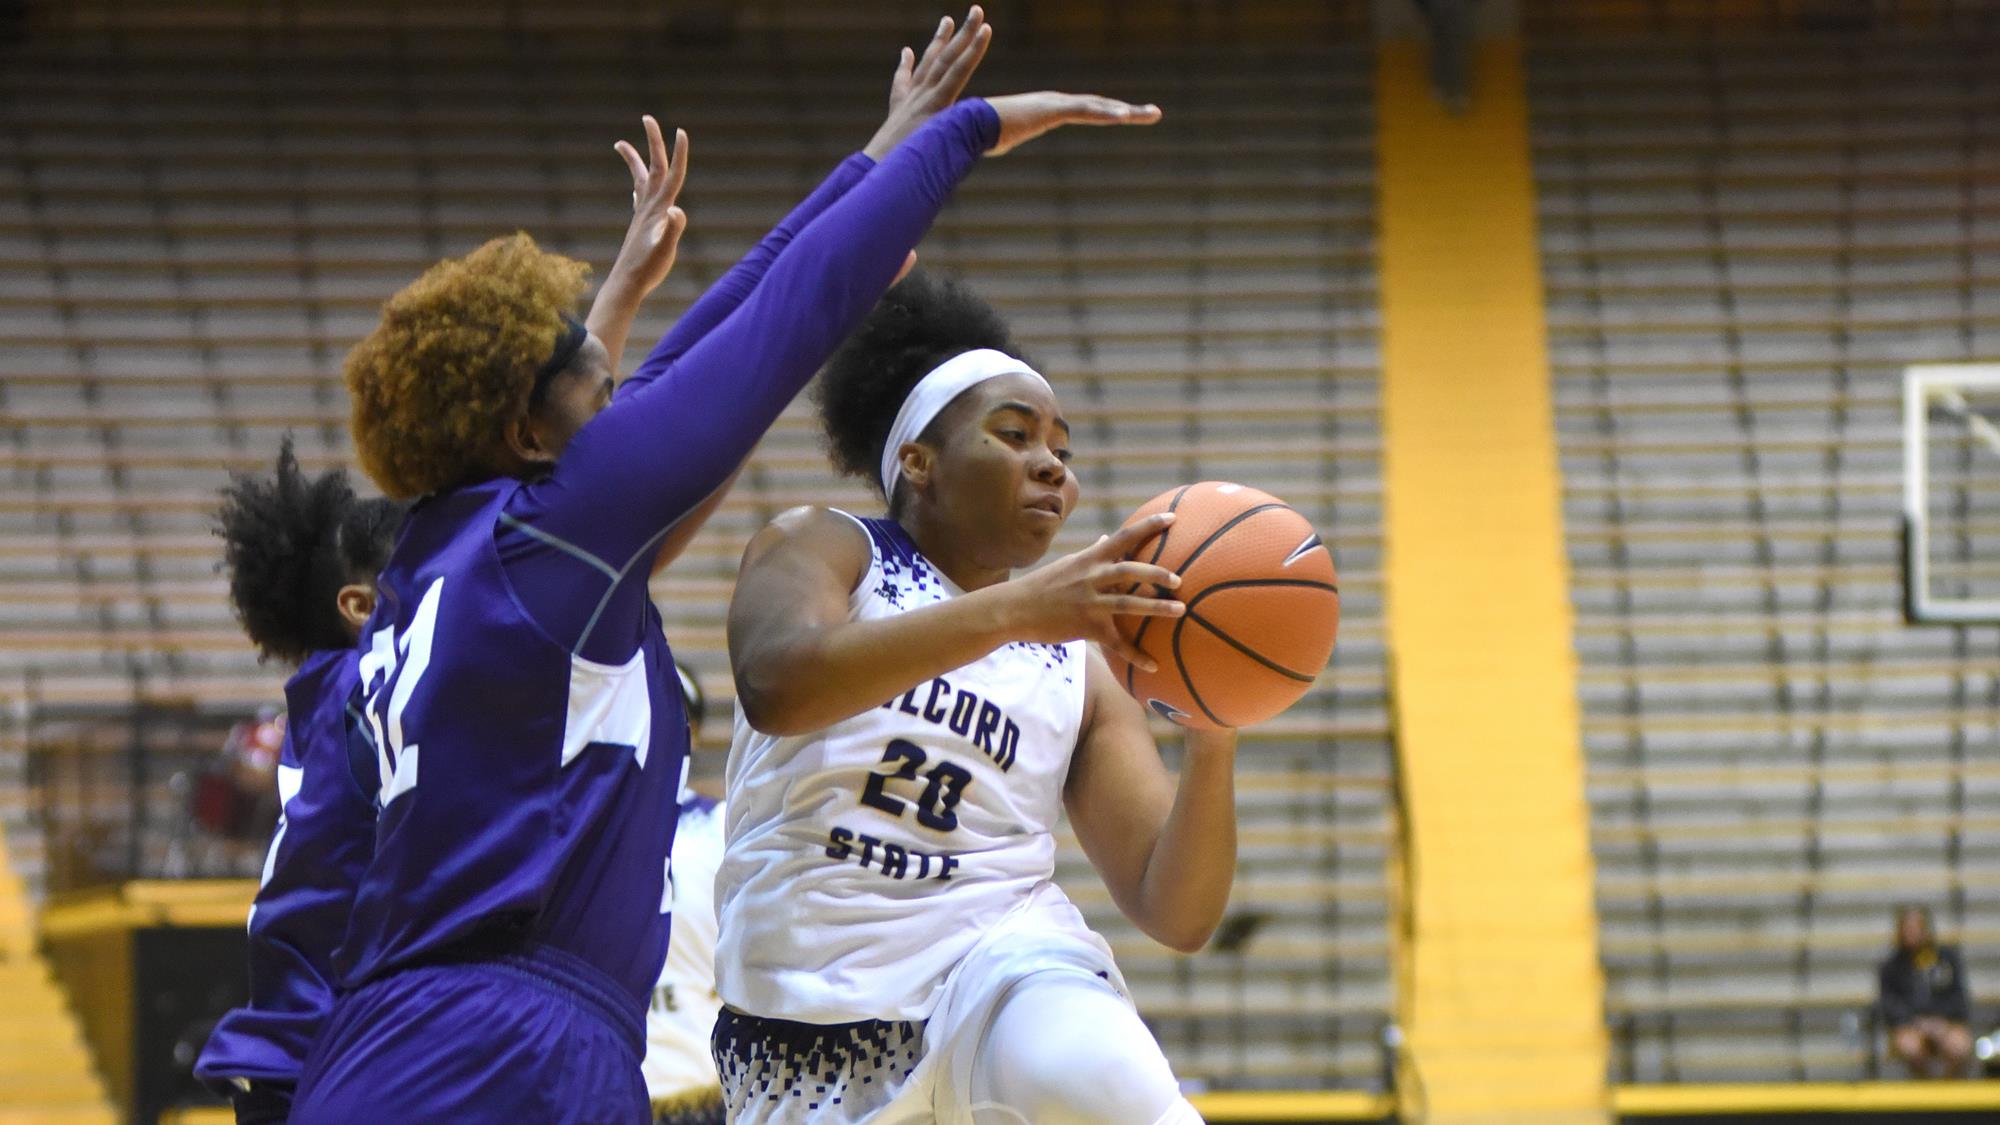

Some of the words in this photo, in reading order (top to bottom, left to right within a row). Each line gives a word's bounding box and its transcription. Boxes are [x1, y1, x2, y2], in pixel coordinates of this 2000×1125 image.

[880, 677, 1020, 773] LCORN
[860, 738, 972, 832] 20
[825, 826, 960, 881] STATE
